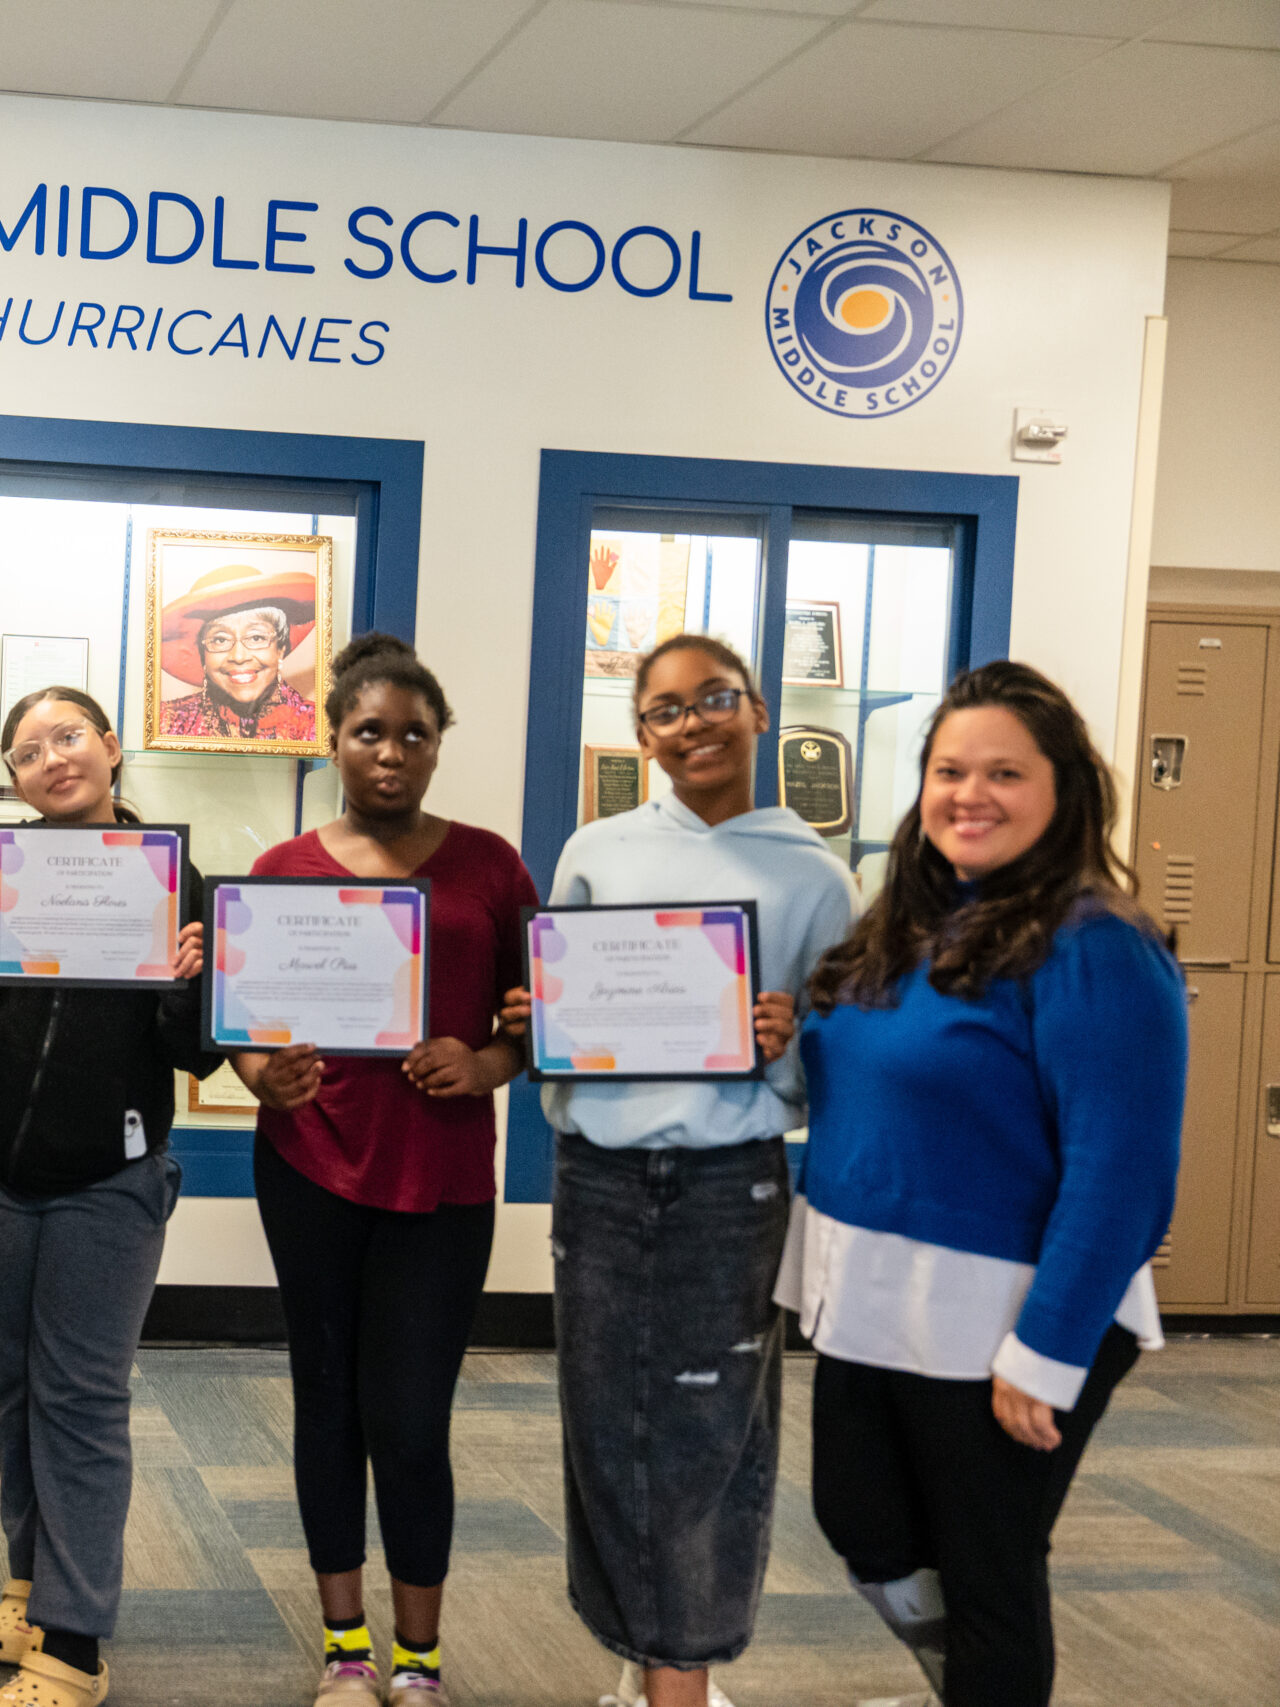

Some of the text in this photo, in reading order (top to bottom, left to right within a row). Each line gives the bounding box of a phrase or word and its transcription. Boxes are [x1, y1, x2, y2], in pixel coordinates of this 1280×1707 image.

[344, 206, 733, 303] SCHOOL
[788, 217, 949, 286] JACKSON
[773, 307, 955, 410] MIDDLE SCHOOL
[46, 856, 124, 867] CERTIFICATE
[277, 915, 363, 927] CERTIFICATE
